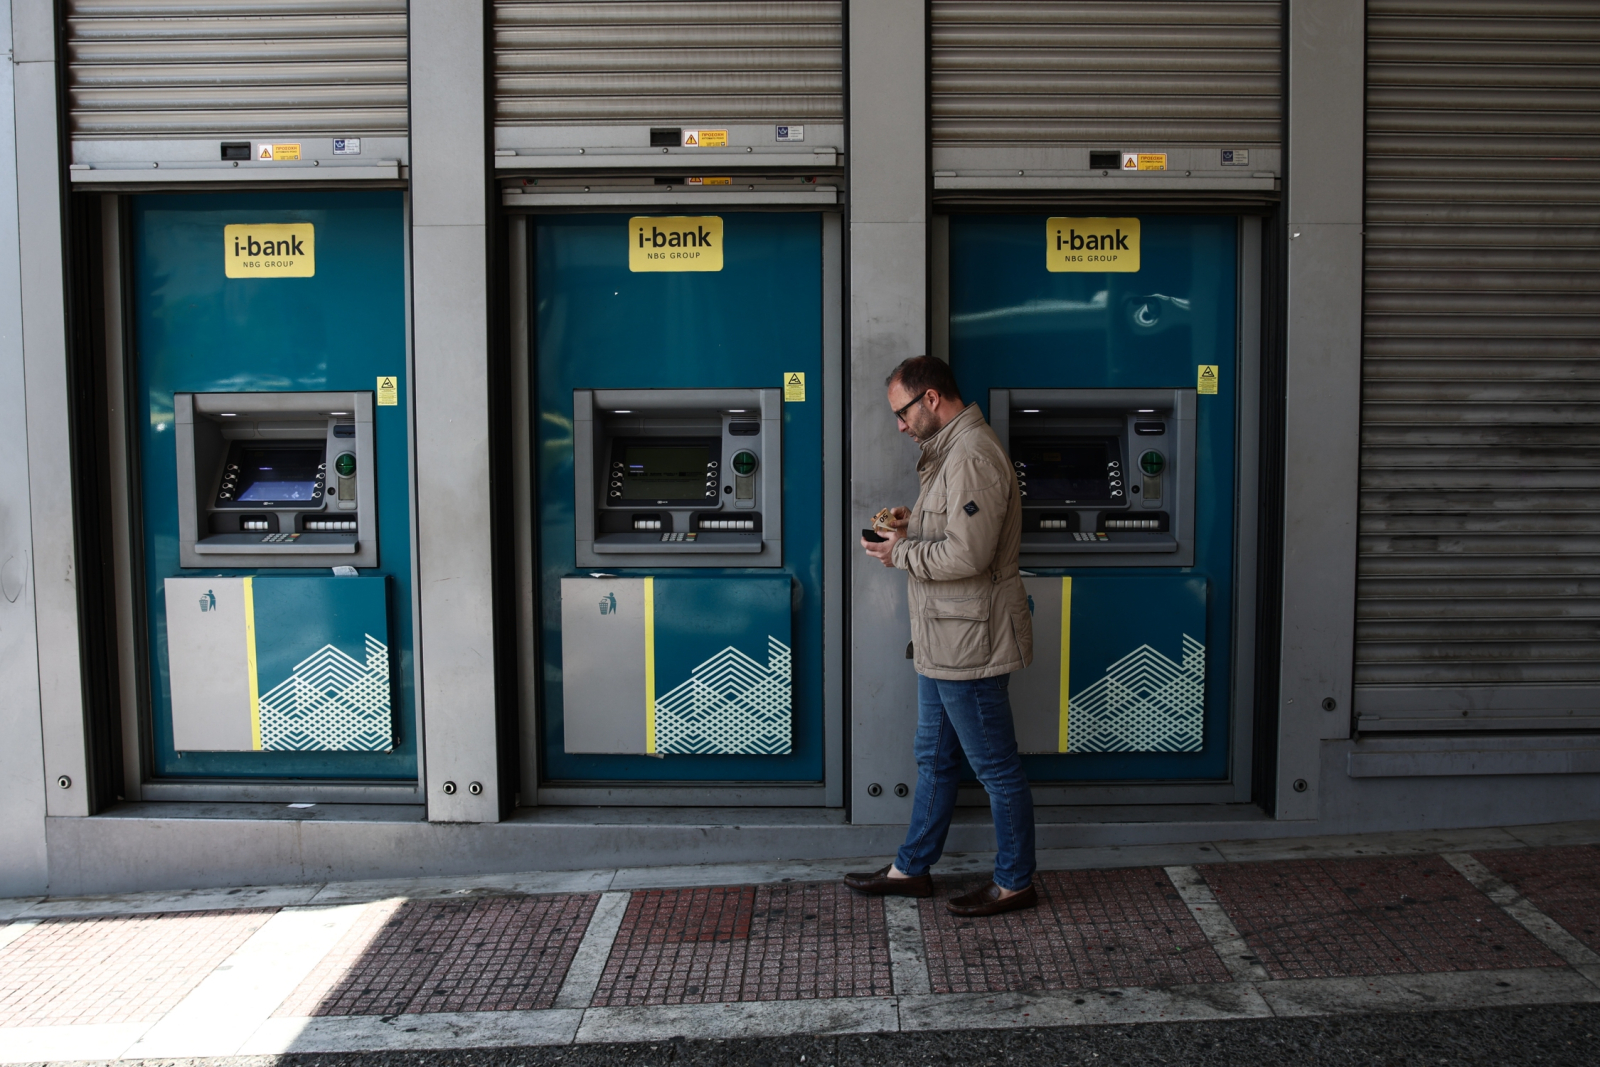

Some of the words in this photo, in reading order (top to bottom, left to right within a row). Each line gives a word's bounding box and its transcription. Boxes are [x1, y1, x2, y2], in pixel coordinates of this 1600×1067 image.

[639, 226, 712, 248] i-bank
[1056, 229, 1129, 251] i-bank
[234, 234, 305, 257] i-bank
[243, 260, 261, 268] NBG
[264, 260, 294, 268] GROUP
[647, 252, 666, 260] NBG
[879, 513, 889, 523] 50
